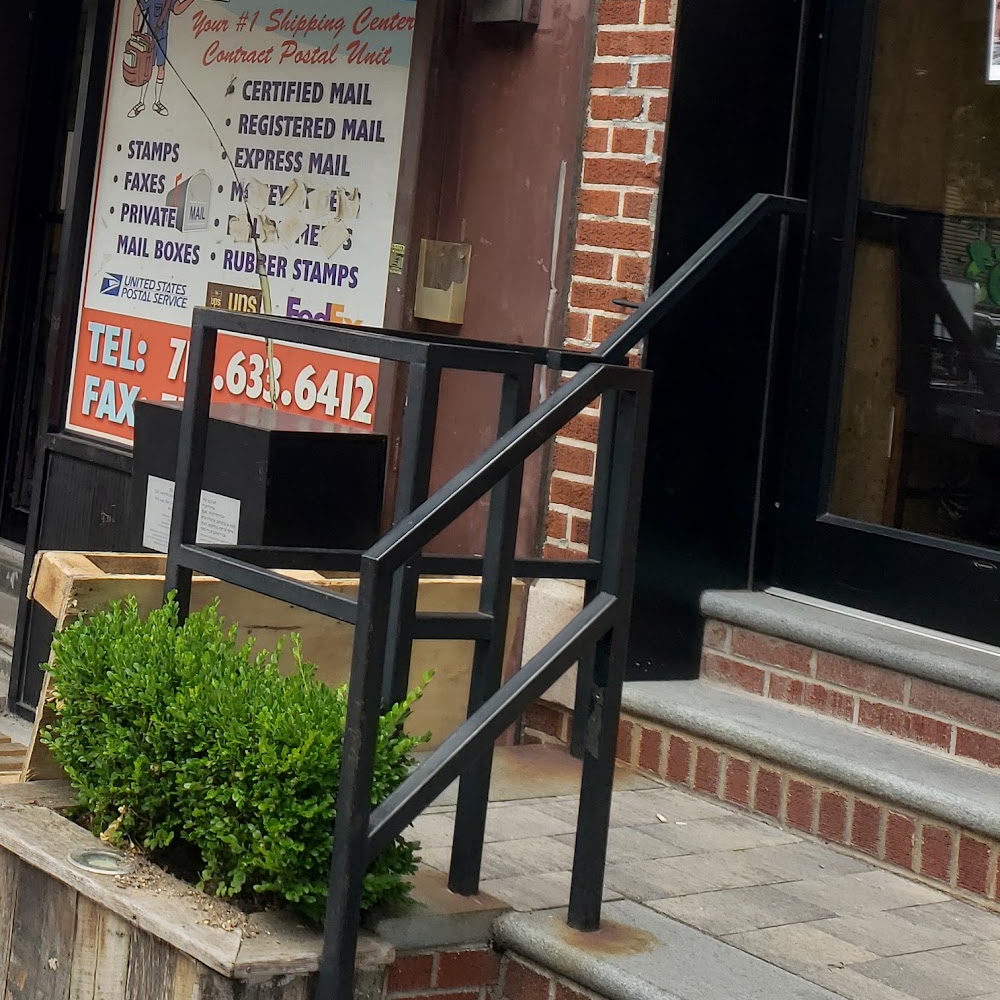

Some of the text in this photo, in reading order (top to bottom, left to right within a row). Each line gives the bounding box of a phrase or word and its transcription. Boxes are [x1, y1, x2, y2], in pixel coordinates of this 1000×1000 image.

[192, 6, 416, 39] Your #1 Shipping Center
[202, 40, 393, 66] Contract Postal Unit
[242, 80, 372, 105] CERTIFIED MAIL
[238, 114, 385, 142] REGISTERED MAIL
[127, 140, 180, 162] STAMPS
[234, 147, 350, 176] EXPRESS MAIL
[124, 171, 166, 194] FAXES
[120, 202, 177, 228] PRIVATE
[189, 205, 205, 220] MAIL
[117, 234, 200, 265] MAIL BOXES
[124, 275, 187, 295] UNITED STATES
[292, 258, 359, 288] STAMPS
[121, 287, 188, 309] POSTAL SERVICE
[88, 321, 147, 373] TEL:
[82, 374, 147, 428] FAX
